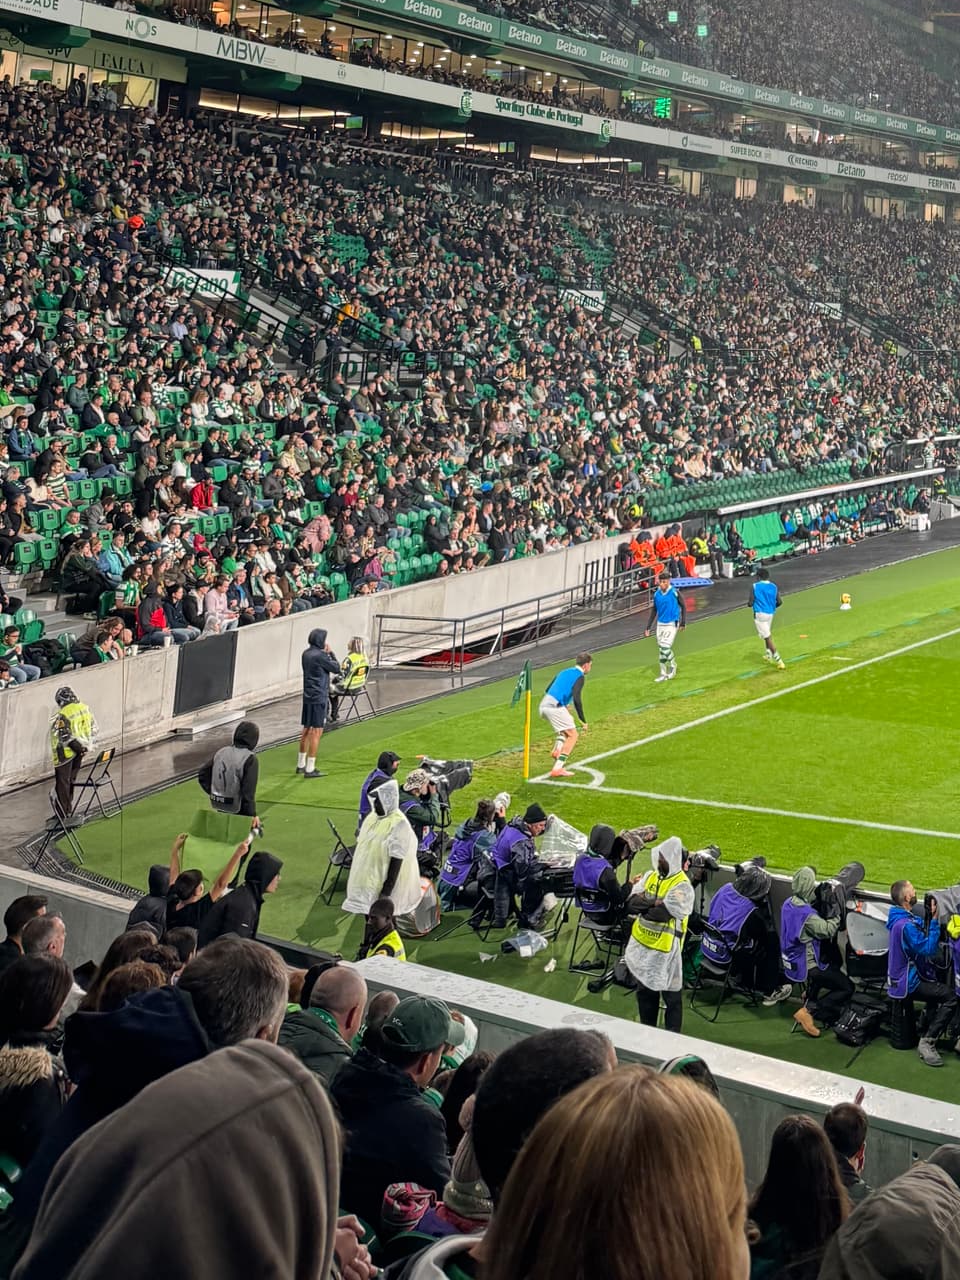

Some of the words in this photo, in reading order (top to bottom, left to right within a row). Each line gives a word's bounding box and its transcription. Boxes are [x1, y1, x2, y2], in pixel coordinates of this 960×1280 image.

[126, 17, 157, 39] NOS
[458, 13, 493, 33] Betano
[509, 26, 542, 46] Betano
[216, 36, 266, 65] MBW
[556, 38, 587, 58] Betano
[600, 51, 628, 68] Betano
[641, 61, 670, 78] Betano
[682, 71, 709, 88] Betano
[720, 81, 744, 96] Betano
[755, 88, 780, 103] Betano
[495, 98, 525, 116] Sporting
[526, 104, 545, 116] Clube
[546, 107, 556, 119] de
[556, 110, 584, 127] Portugal
[790, 98, 813, 112] Betano
[730, 145, 748, 156] SUPER
[837, 162, 866, 178] Betano
[887, 172, 908, 182] repsol
[928, 178, 957, 191] FERPINTA
